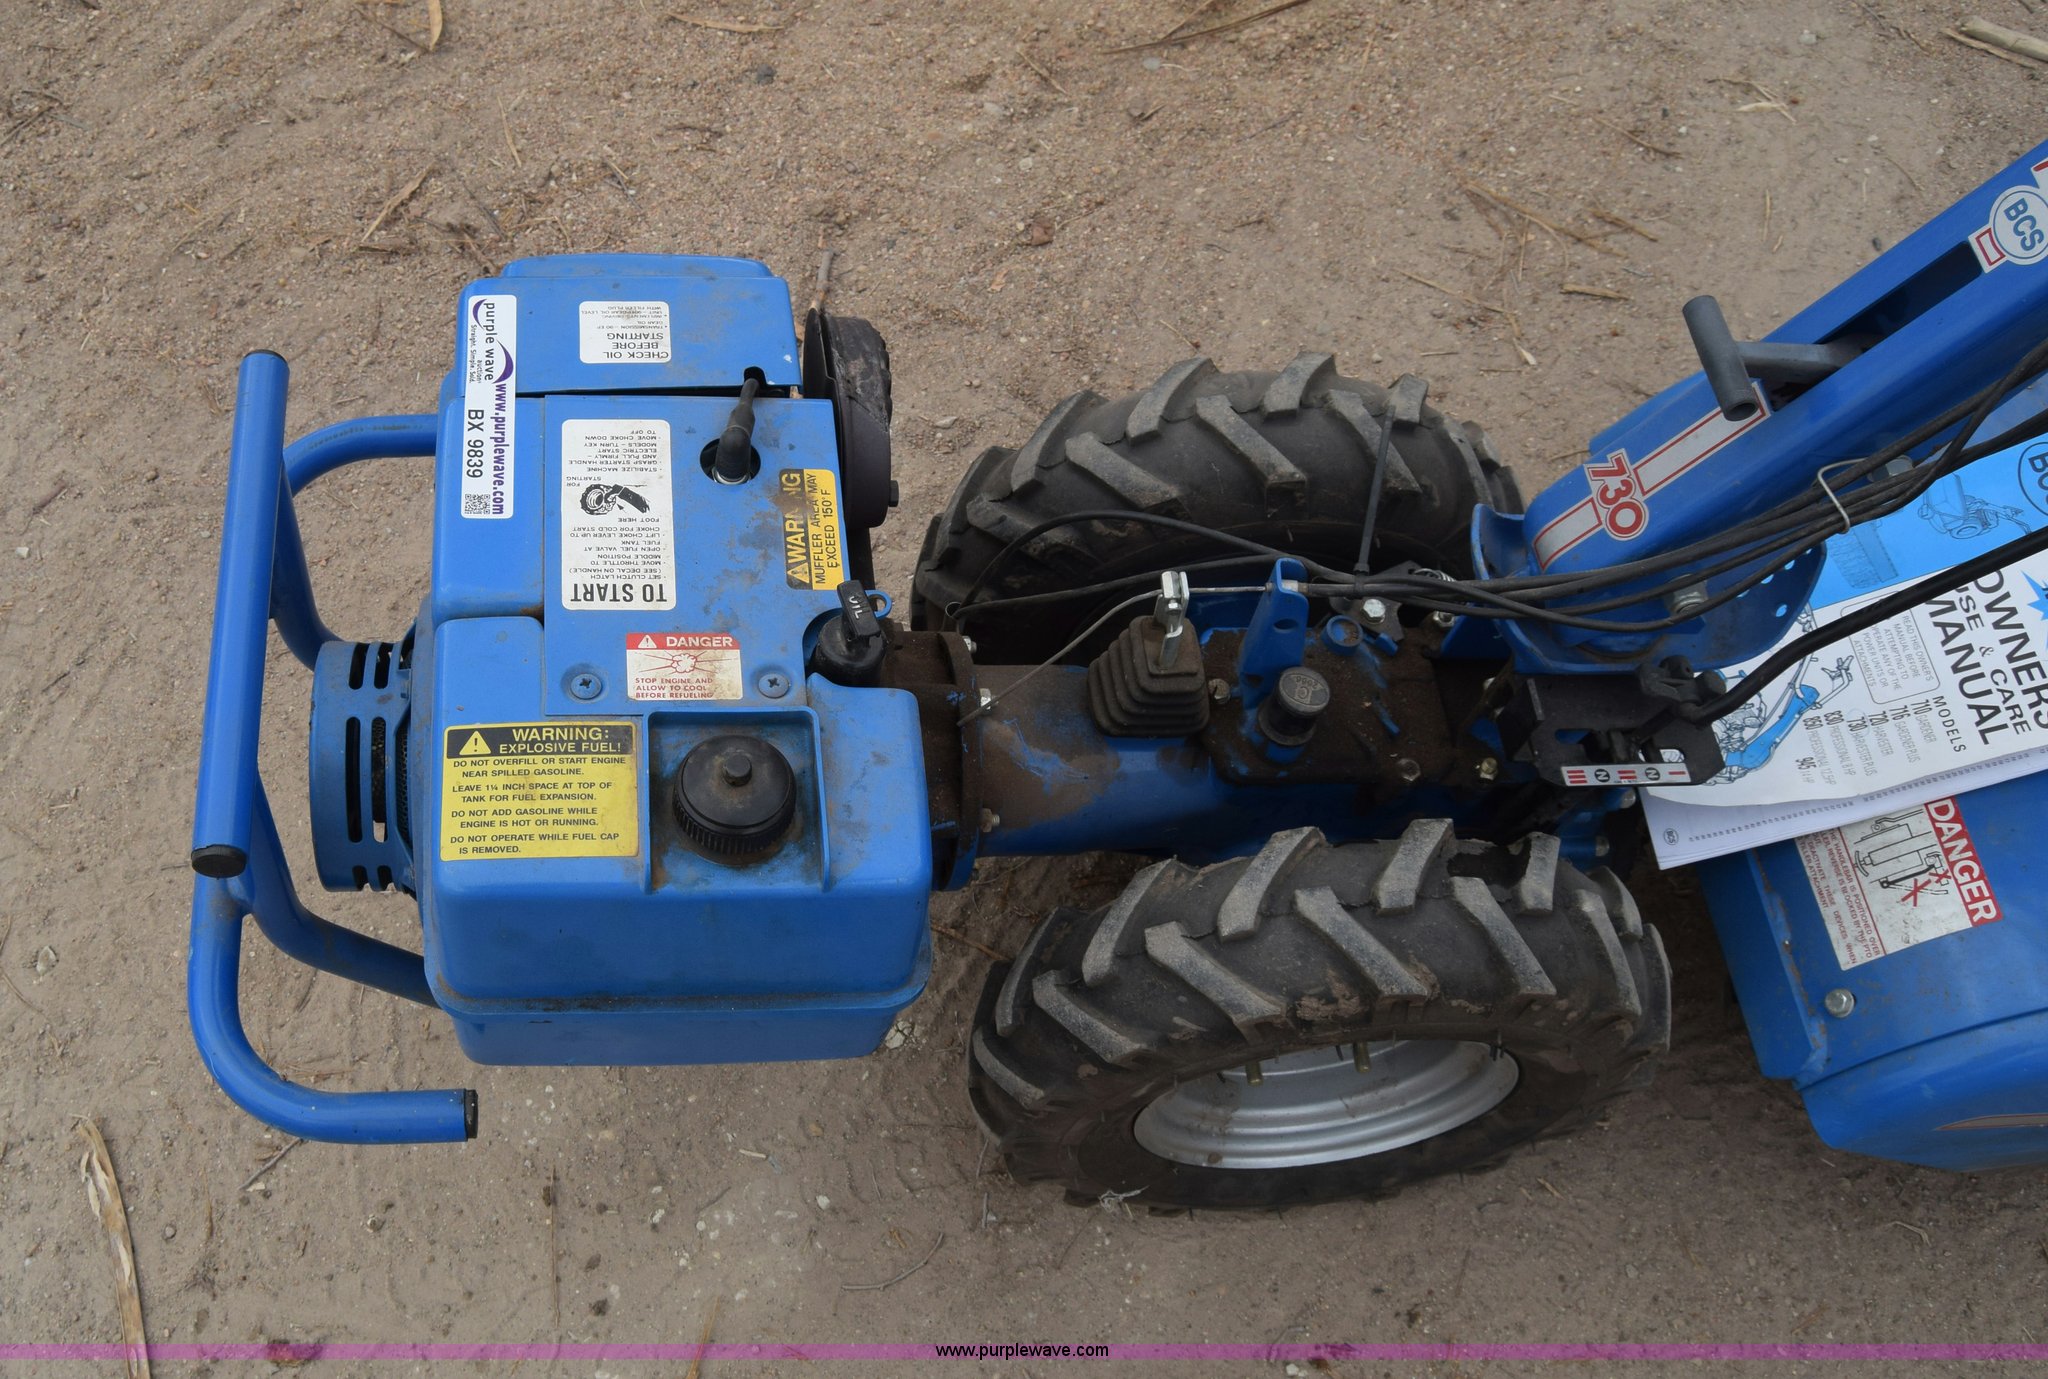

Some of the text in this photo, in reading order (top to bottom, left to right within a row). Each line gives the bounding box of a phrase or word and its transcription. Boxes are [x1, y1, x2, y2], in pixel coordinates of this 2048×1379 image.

[2003, 197, 2044, 251] BCS
[483, 302, 497, 381] purple wave
[606, 332, 664, 340] STARTING
[602, 351, 669, 359] CHECK OIL
[466, 409, 484, 478] BX 9839
[490, 383, 510, 515] www.purplewave.com
[806, 473, 818, 494] MAY
[1588, 453, 1646, 537] 730
[824, 524, 838, 568] EXCEED
[811, 533, 826, 584] MUFFLER
[570, 583, 667, 603] TO START
[666, 636, 733, 647] DANGER
[1978, 646, 1994, 657] &
[1989, 668, 2032, 735] CARE
[1888, 703, 1911, 722] 716
[1910, 698, 1931, 716] 710
[1801, 713, 1823, 732] 850
[1823, 708, 1845, 727] 830
[1846, 715, 1868, 733] 730
[1867, 709, 1889, 728] 720
[1933, 695, 1967, 753] MODELS
[512, 727, 609, 742] WARNING:
[499, 742, 621, 754] EXPLOSIVE FUEL!
[493, 758, 538, 766] OVERFILL
[1795, 754, 1817, 772] 945
[462, 770, 488, 778] NEAR
[534, 768, 584, 776] GASOLINE.
[452, 784, 482, 792] LEAVE
[502, 783, 525, 791] INCH
[462, 795, 486, 803] TANK
[489, 794, 509, 802] FOR
[540, 793, 596, 801] EXPANSION.
[451, 810, 465, 818] DO
[567, 807, 598, 815] WHILE
[460, 820, 496, 828] ENGINE
[512, 819, 531, 827] HOT
[552, 818, 599, 826] RUNNING.
[468, 835, 487, 843] NOT
[490, 834, 535, 842] OPERATE
[538, 833, 569, 841] WHILE
[572, 833, 597, 841] FUEL
[472, 846, 521, 854] REMOVED.
[1925, 795, 1999, 926] DANGER
